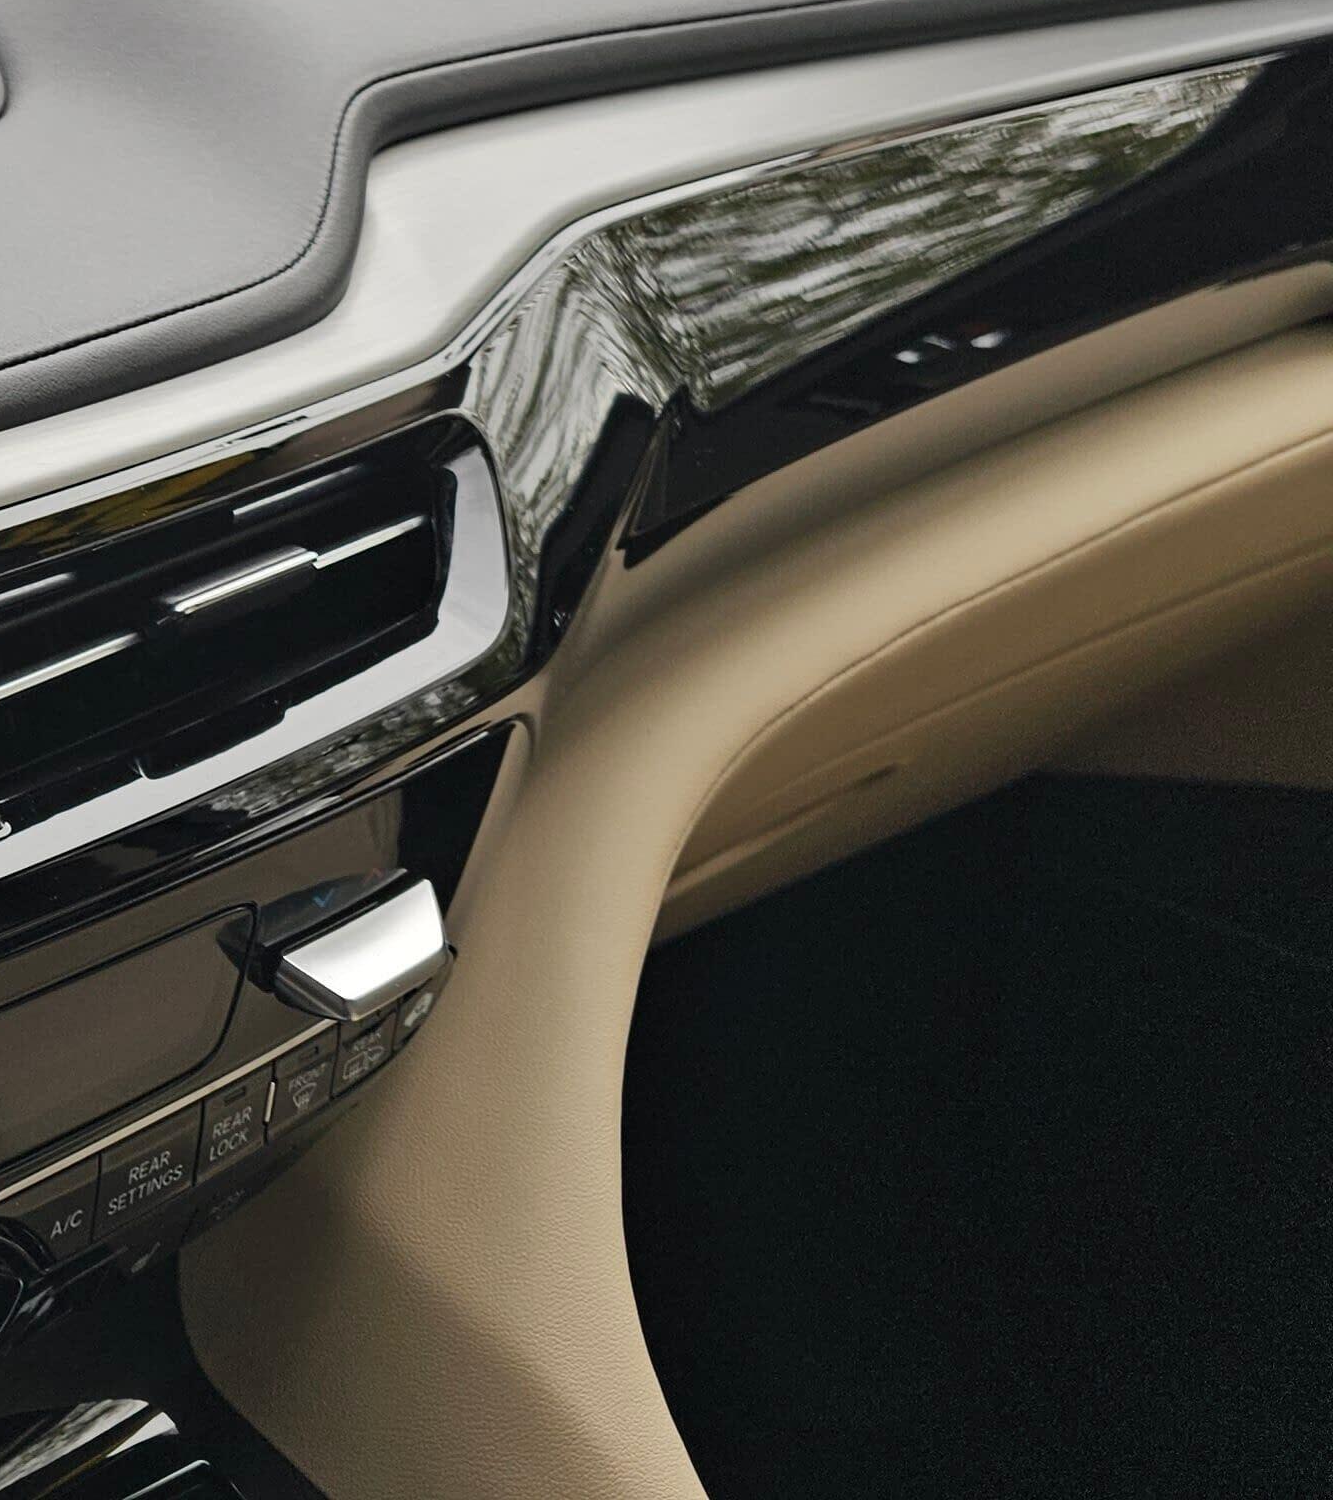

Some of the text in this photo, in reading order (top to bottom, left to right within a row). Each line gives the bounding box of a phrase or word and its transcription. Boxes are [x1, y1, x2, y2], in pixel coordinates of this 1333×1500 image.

[213, 1106, 252, 1139] REAR
[209, 1128, 248, 1162] LOCK
[128, 1151, 171, 1184] REAR
[107, 1165, 183, 1216] SETTINGS
[50, 1210, 83, 1238] A/C
